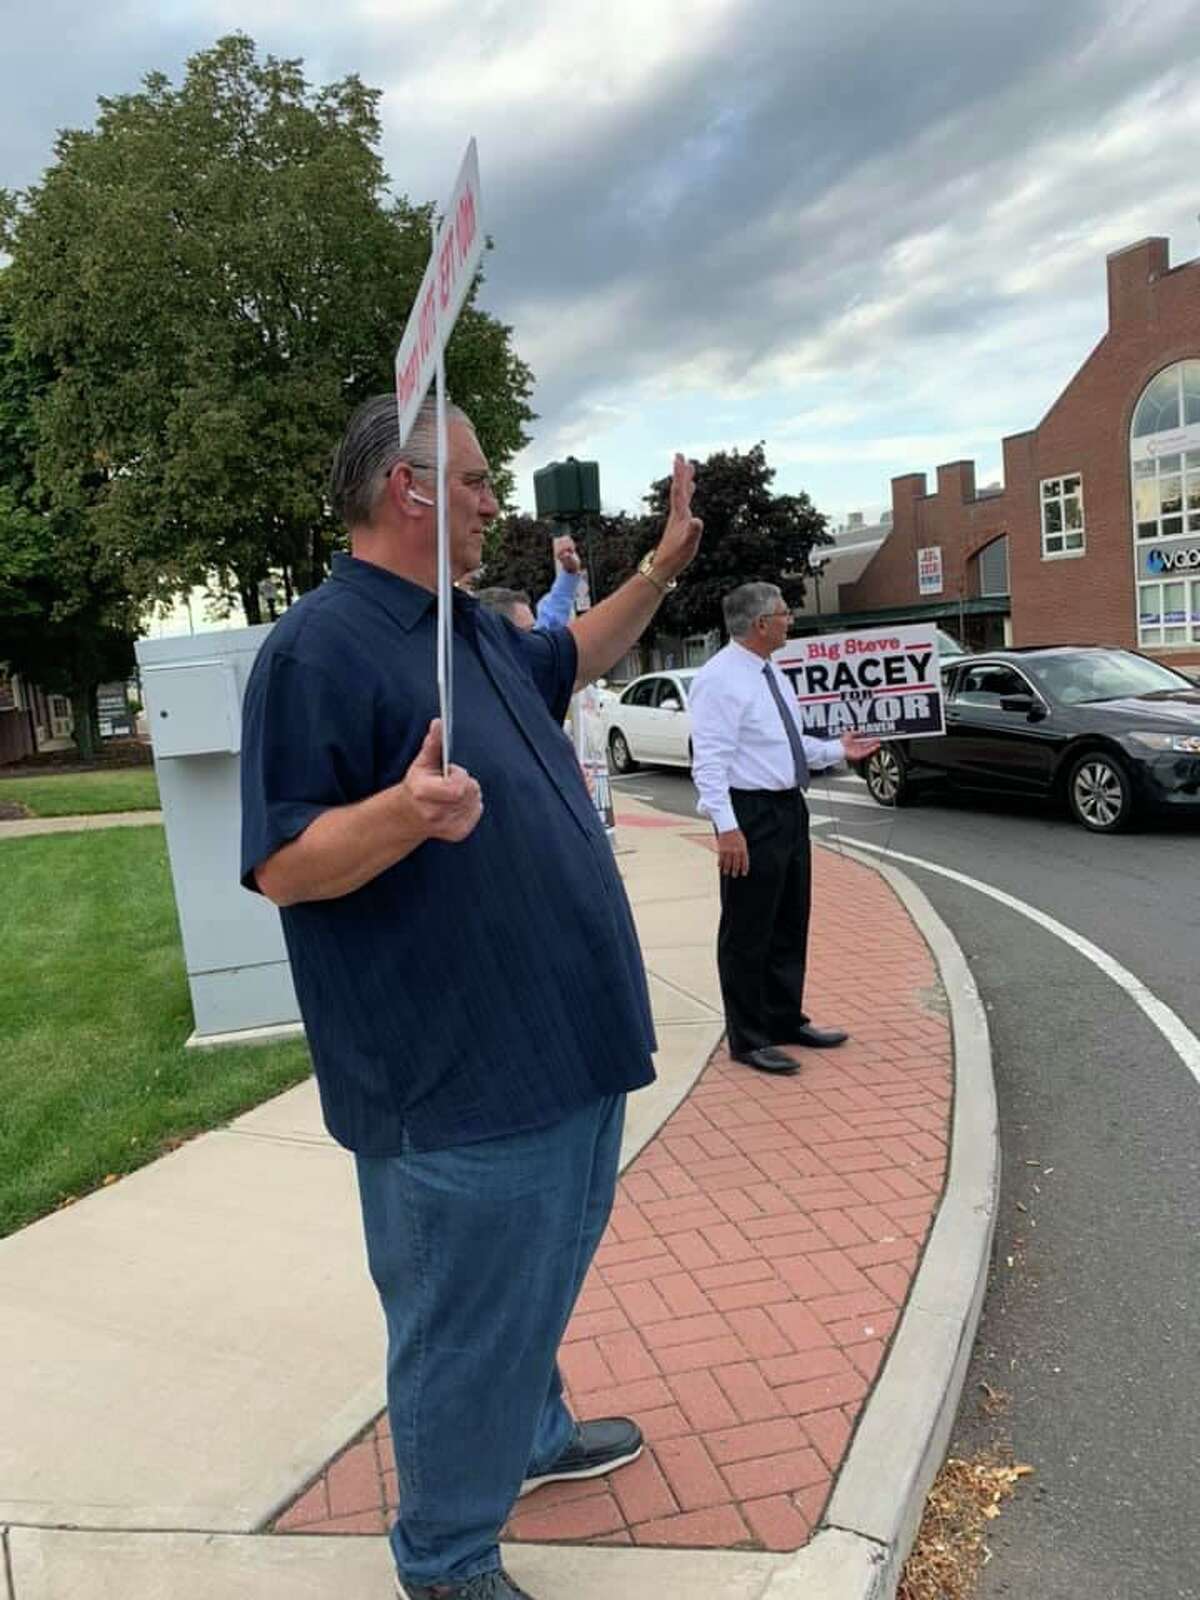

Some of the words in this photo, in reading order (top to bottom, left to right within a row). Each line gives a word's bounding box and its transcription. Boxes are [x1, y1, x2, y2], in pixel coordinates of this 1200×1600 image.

[807, 642, 841, 660] Big
[845, 637, 900, 654] Steve
[782, 653, 932, 694] TRACEY
[840, 689, 874, 701] FOR
[800, 694, 931, 728] MAYOR
